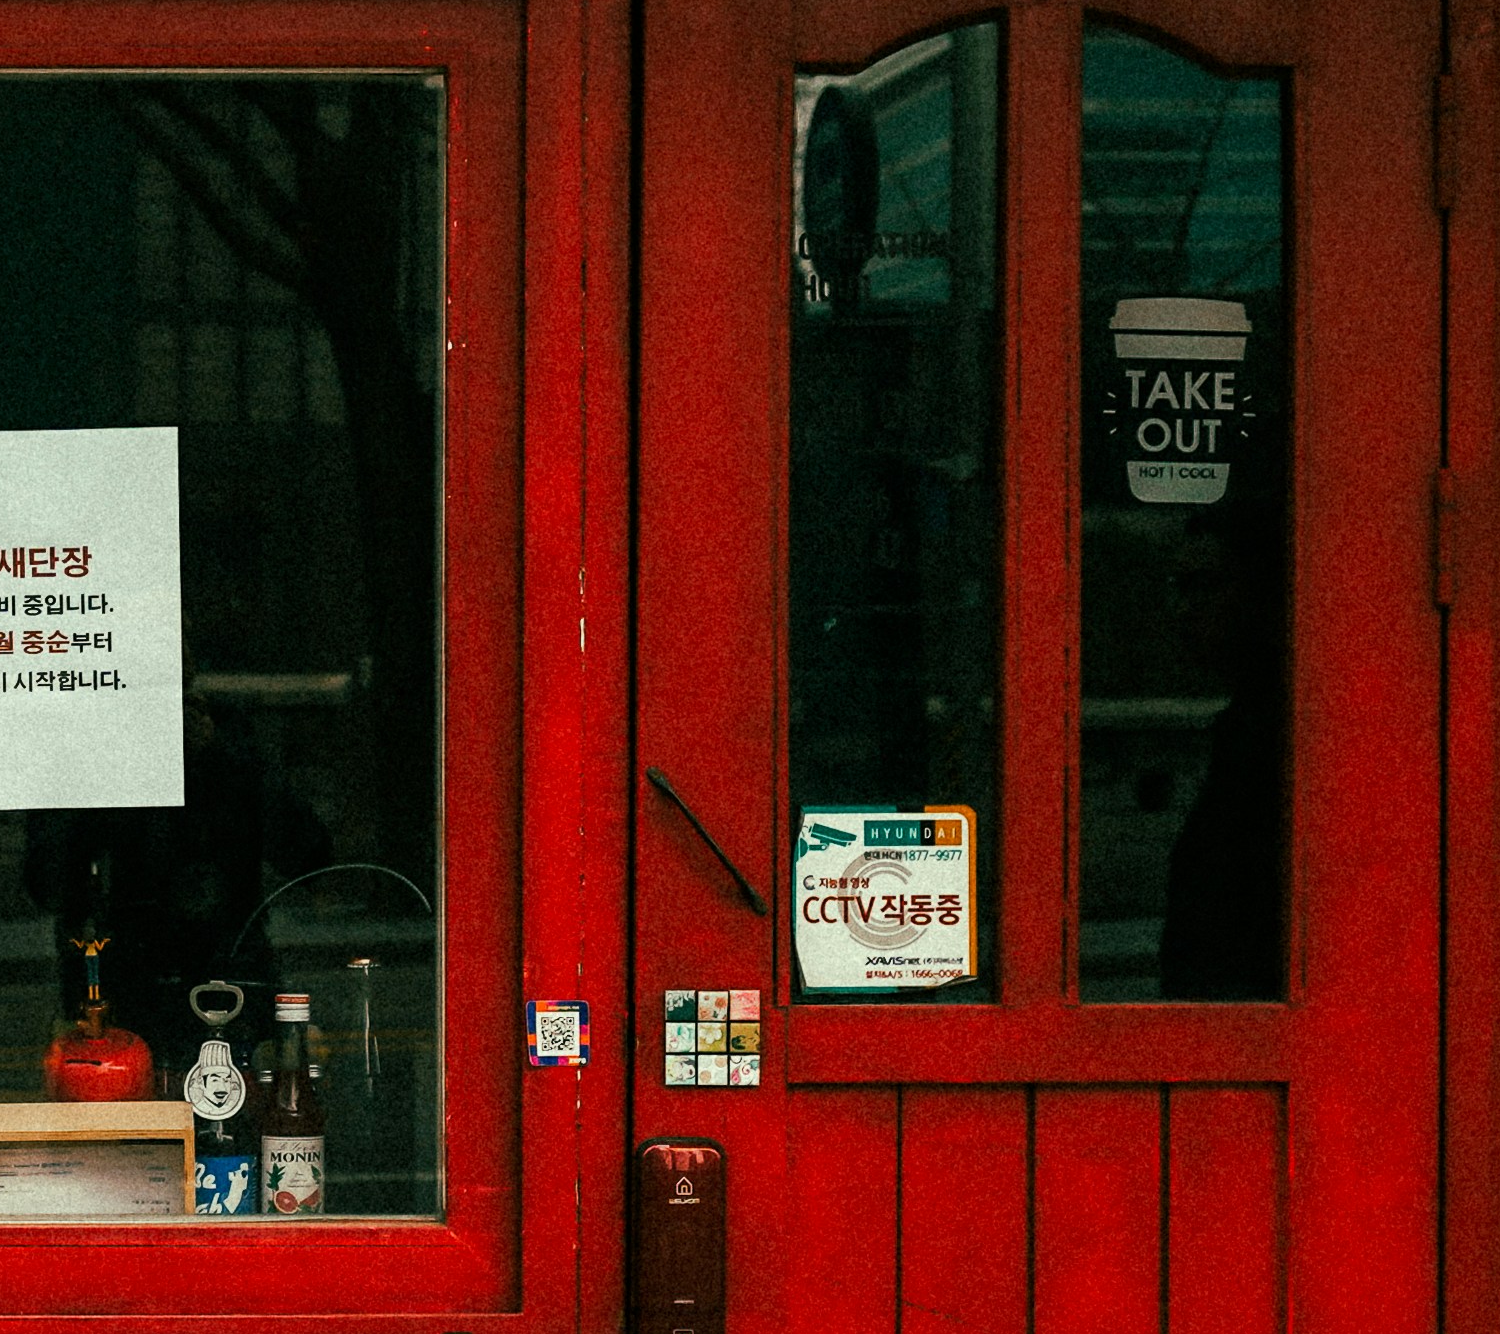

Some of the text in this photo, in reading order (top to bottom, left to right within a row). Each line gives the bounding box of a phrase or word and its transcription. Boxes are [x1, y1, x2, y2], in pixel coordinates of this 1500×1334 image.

[1126, 370, 1235, 410] TAKE
[1138, 418, 1222, 453] OUT
[1139, 467, 1217, 479] HOT COOL
[22, 594, 114, 616] 중입니다.
[21, 630, 112, 654] 중순부터
[14, 670, 127, 692] 시작합니다.
[871, 827, 956, 839] HYUNDAI
[803, 894, 962, 925] CCTV 작동중
[270, 1151, 320, 1163] MONIN
